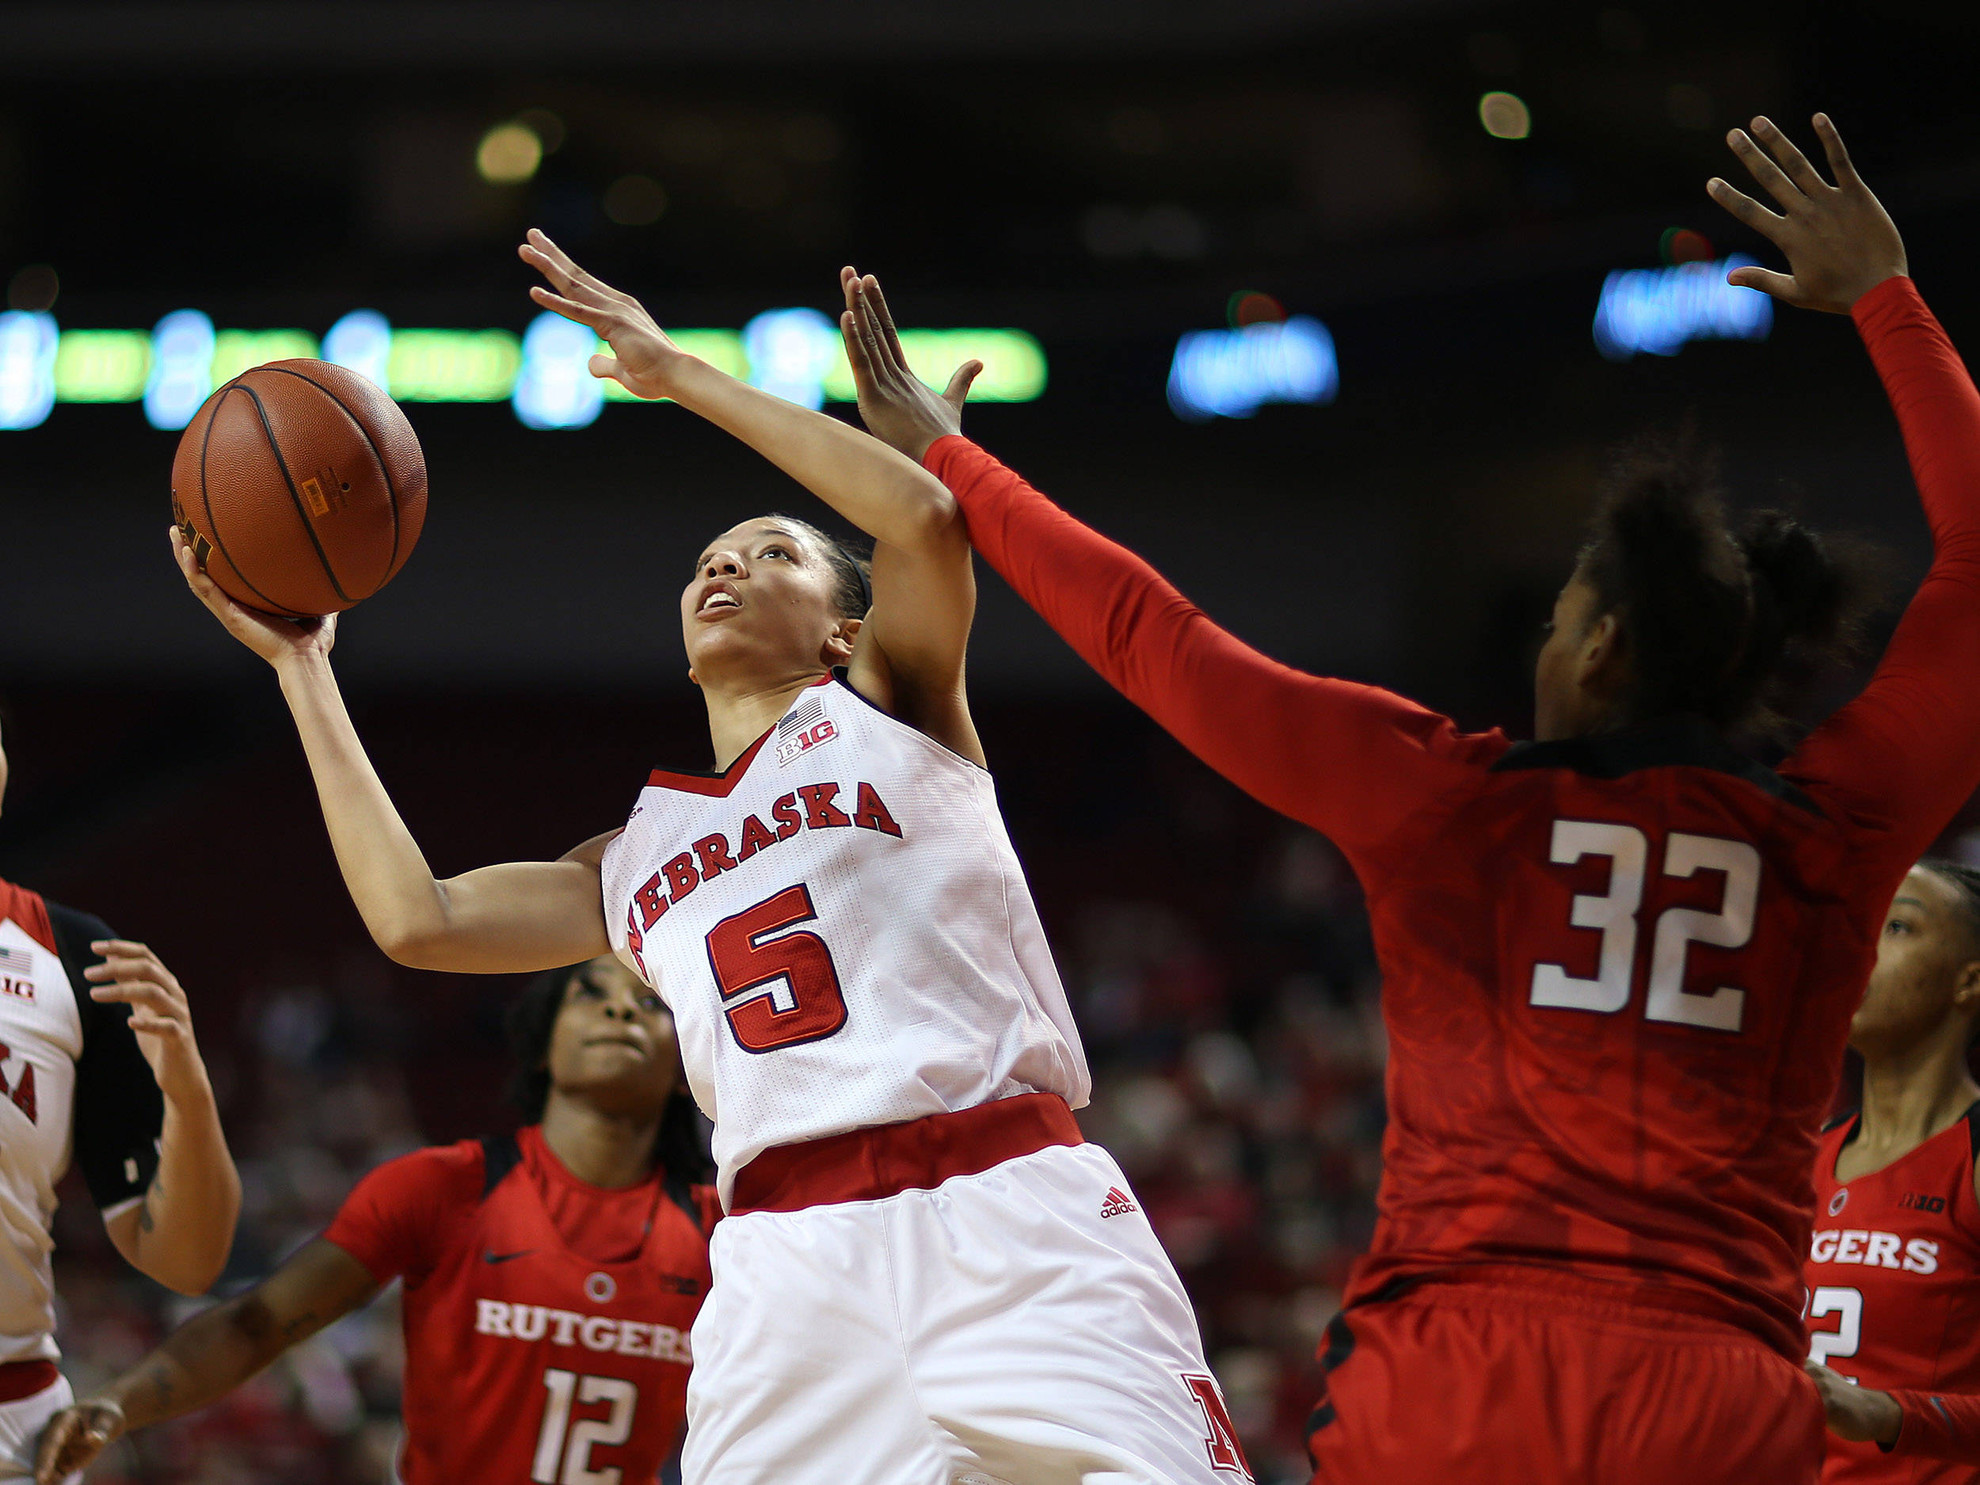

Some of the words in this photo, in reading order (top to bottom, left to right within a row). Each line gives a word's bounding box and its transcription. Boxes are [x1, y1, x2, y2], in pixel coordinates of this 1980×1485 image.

[705, 882, 849, 1055] 5
[1530, 819, 1761, 1032] 32
[1100, 1201, 1138, 1219] adida
[1810, 1229, 1940, 1275] GERS
[1800, 1286, 1863, 1386] 2
[531, 1367, 639, 1485] 12
